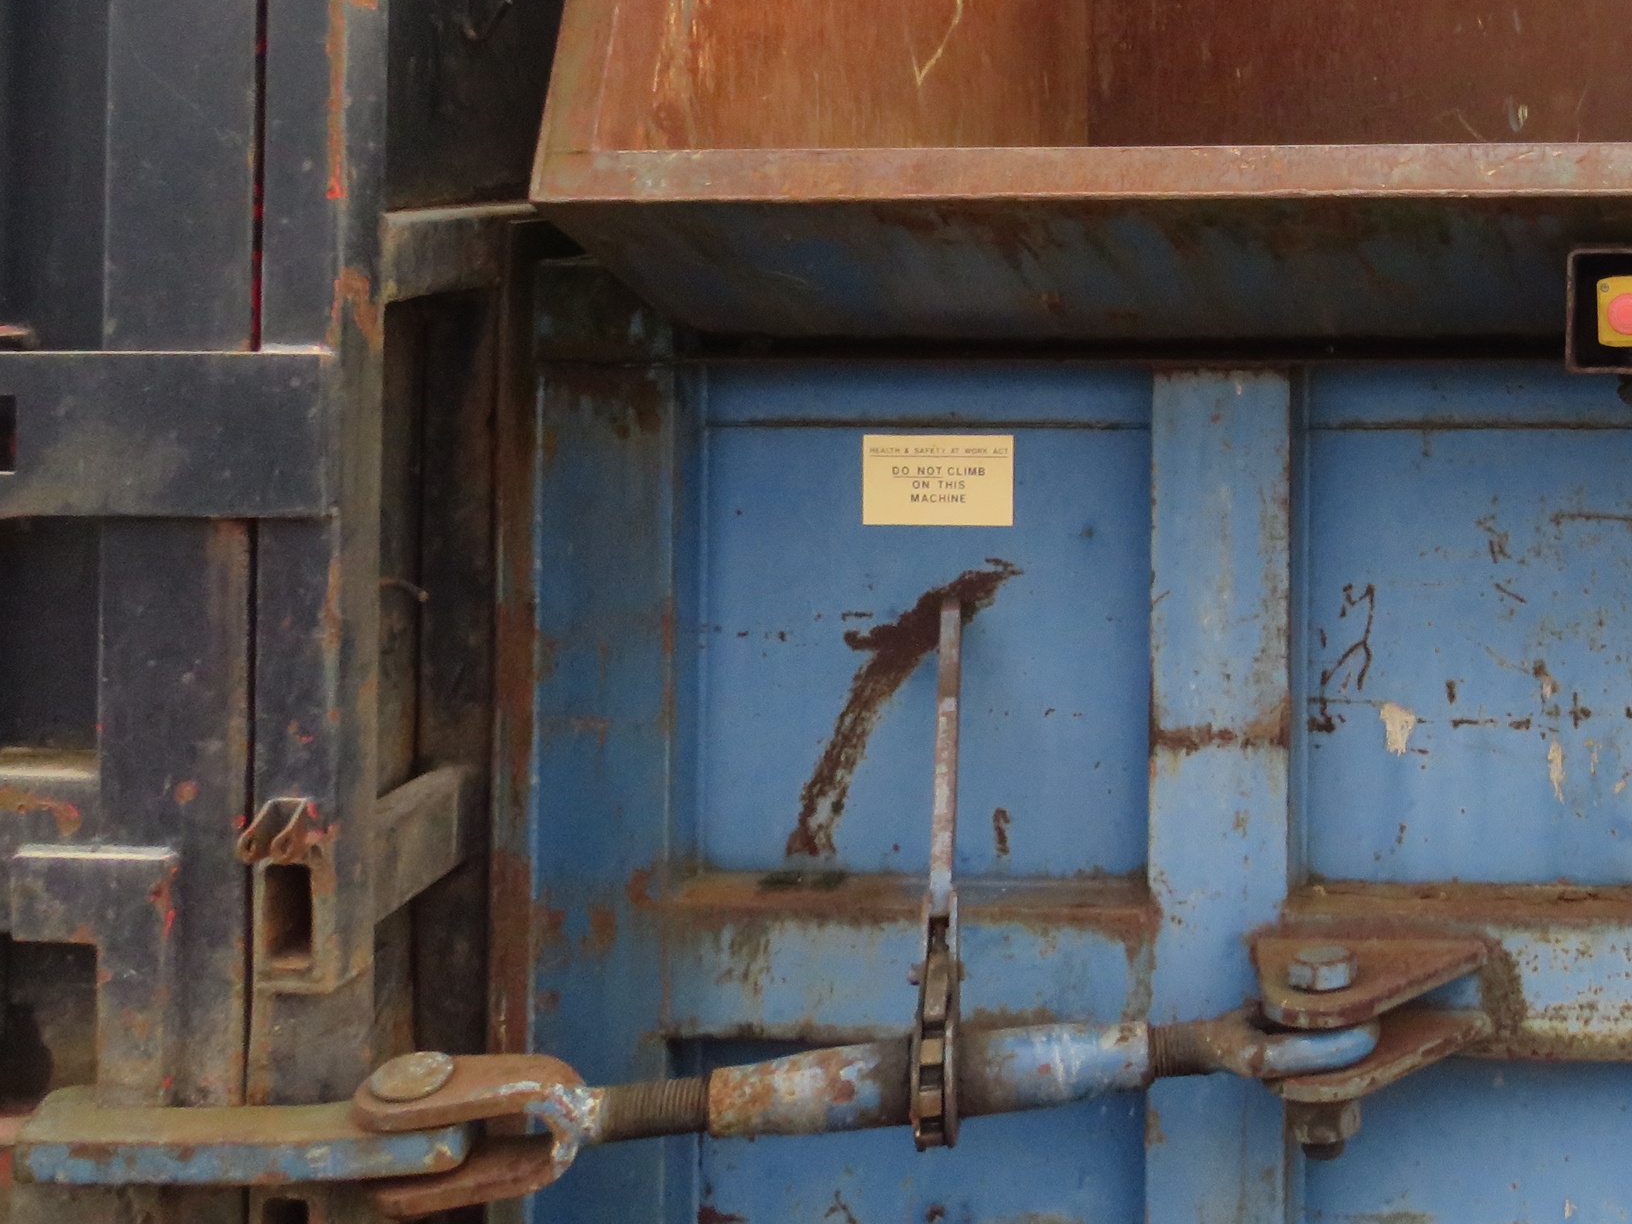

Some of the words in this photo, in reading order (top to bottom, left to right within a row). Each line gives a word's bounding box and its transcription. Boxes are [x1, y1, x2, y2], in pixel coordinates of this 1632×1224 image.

[950, 447, 960, 455] AT
[892, 466, 910, 475] DO
[917, 466, 943, 476] NOT
[947, 466, 986, 476] CLIMB
[912, 480, 930, 489] ON
[938, 480, 966, 490] THIS
[910, 494, 967, 503] MACHINE
